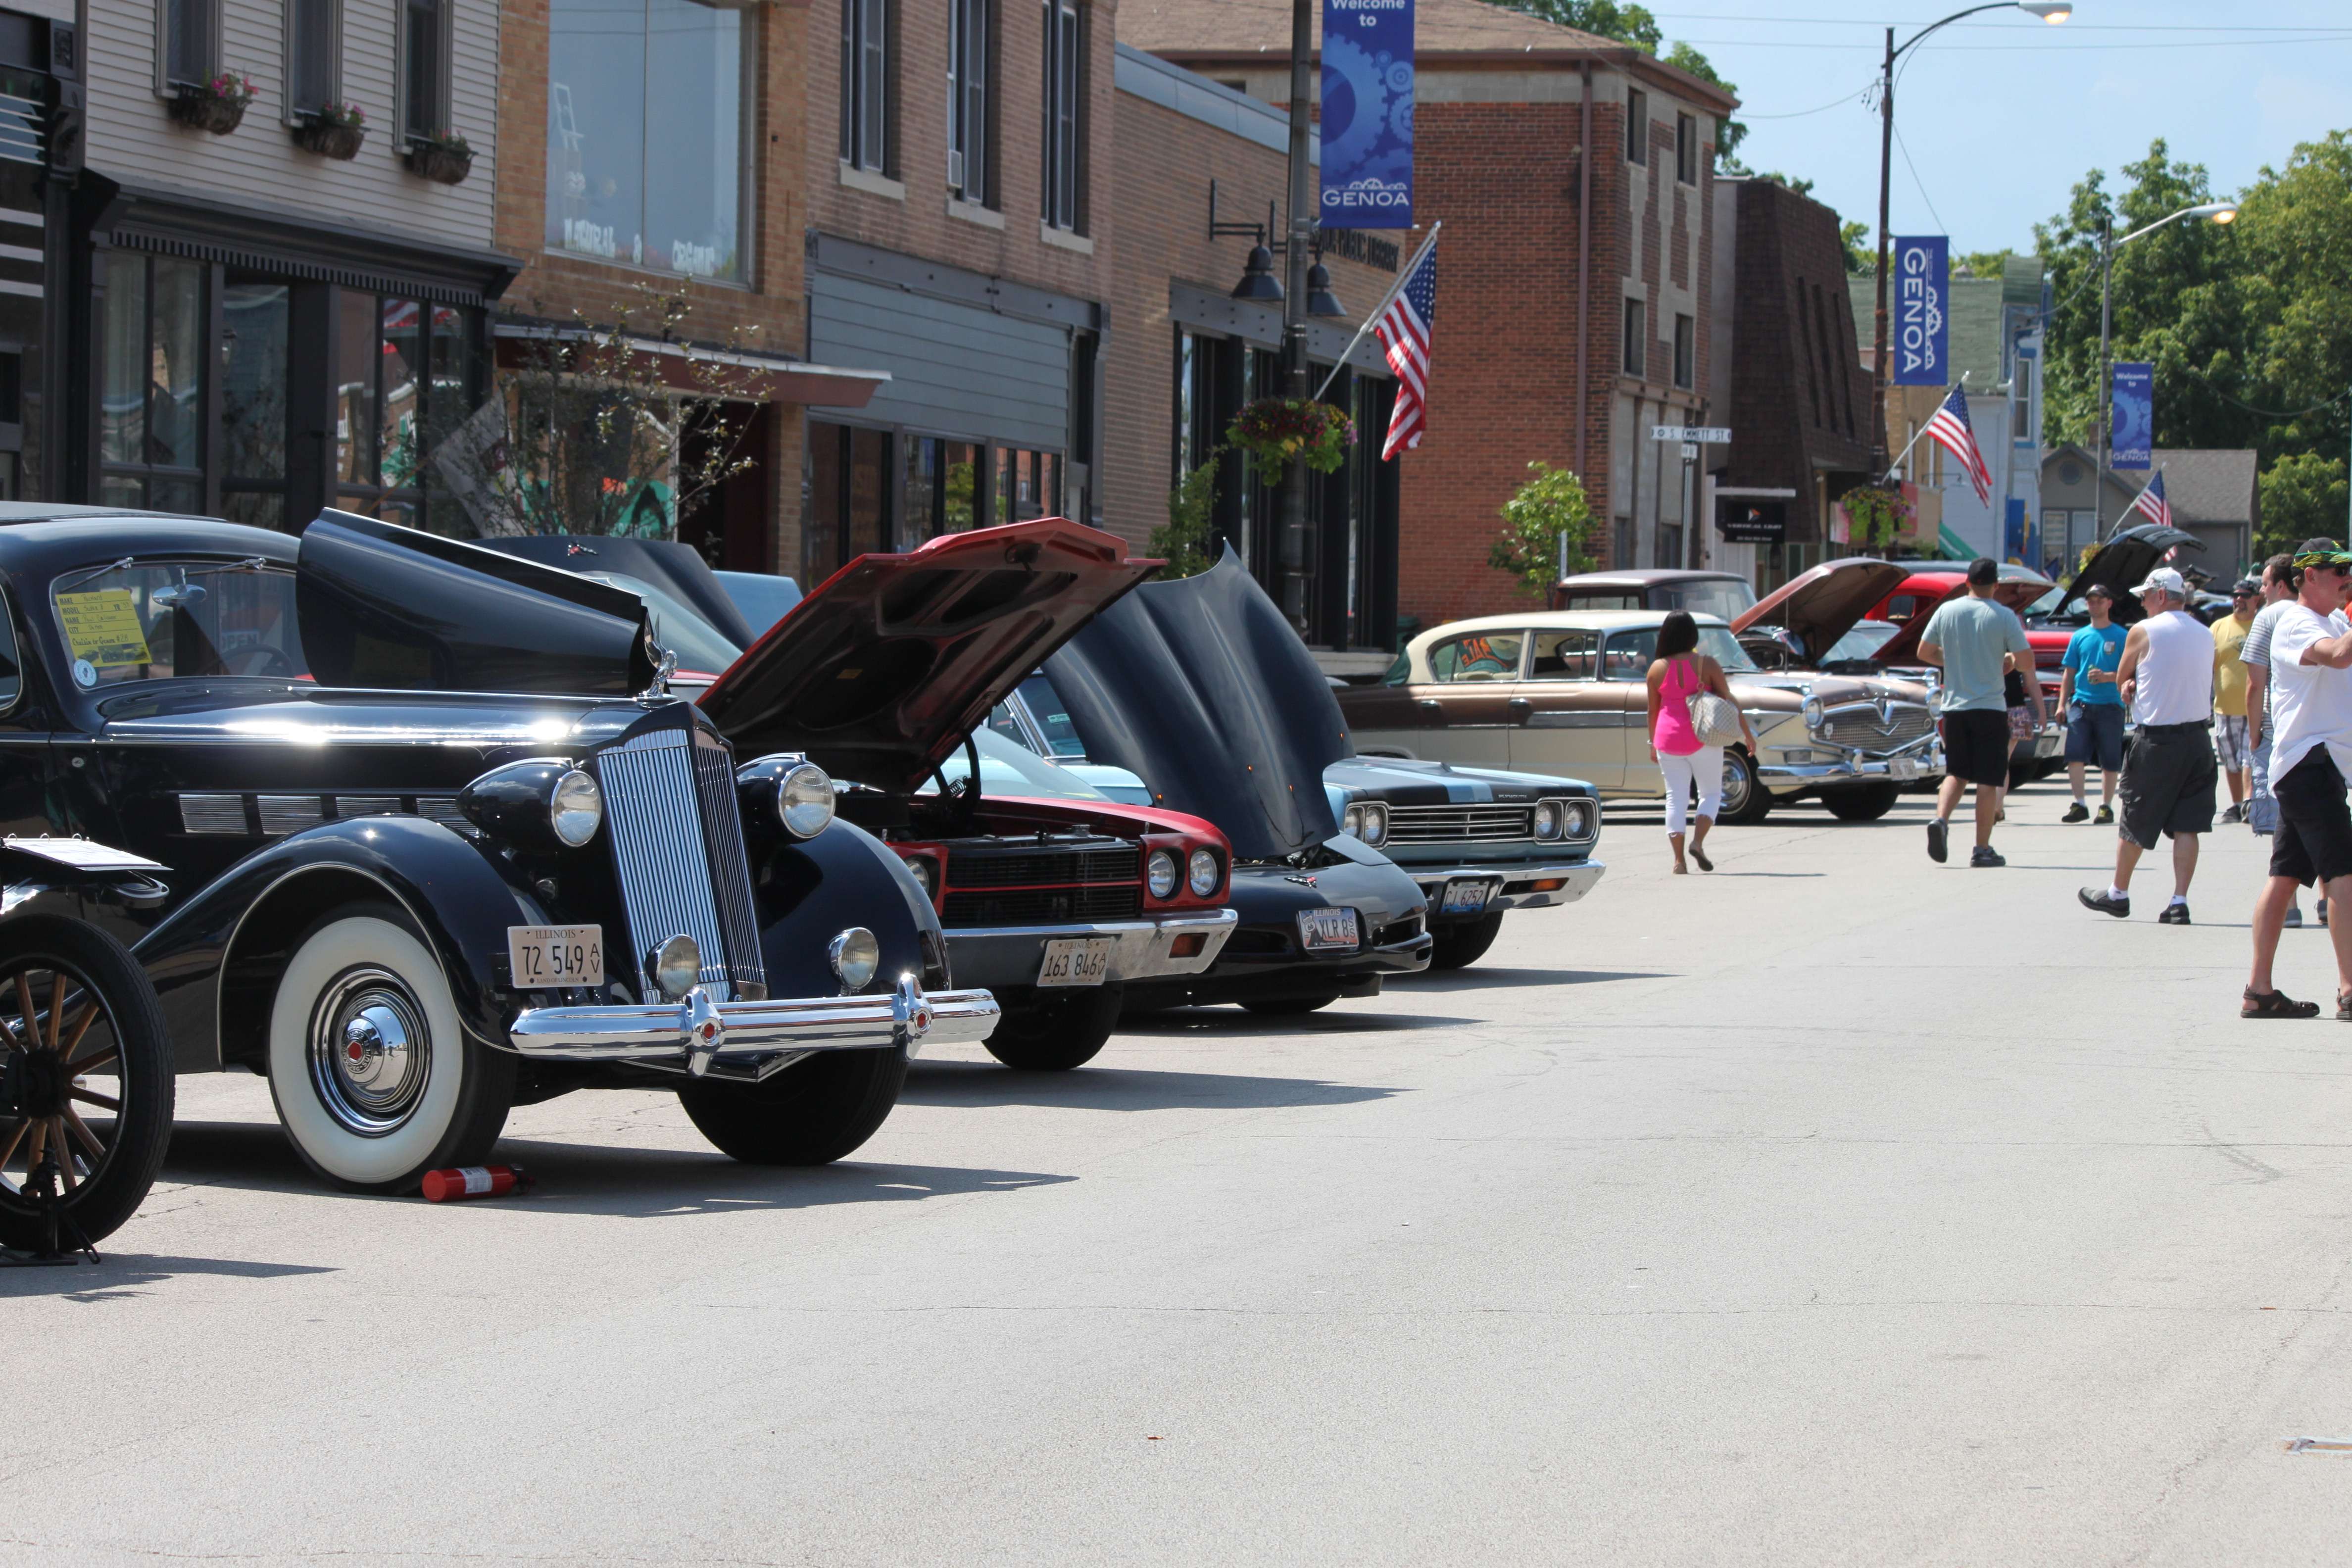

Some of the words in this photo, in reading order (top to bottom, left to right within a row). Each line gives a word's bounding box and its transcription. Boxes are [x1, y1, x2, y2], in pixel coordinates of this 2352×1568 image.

[1332, 0, 1405, 9] Welcome
[1360, 13, 1376, 27] to
[1322, 189, 1410, 206] GENOA
[1368, 236, 1399, 273] LIBRARY
[1903, 247, 1926, 373] GENOA
[2113, 452, 2149, 461] GENOA
[1445, 890, 1458, 906] CJ
[1460, 889, 1483, 906] 6252
[1314, 908, 1341, 917] ILLINOIS
[536, 930, 576, 939] ILLINOIS
[1319, 919, 1339, 939] XLR
[1342, 919, 1349, 937] 8
[522, 946, 542, 975] 72
[552, 945, 583, 975] 549
[1044, 954, 1070, 977] 163
[1075, 953, 1098, 976] 846
